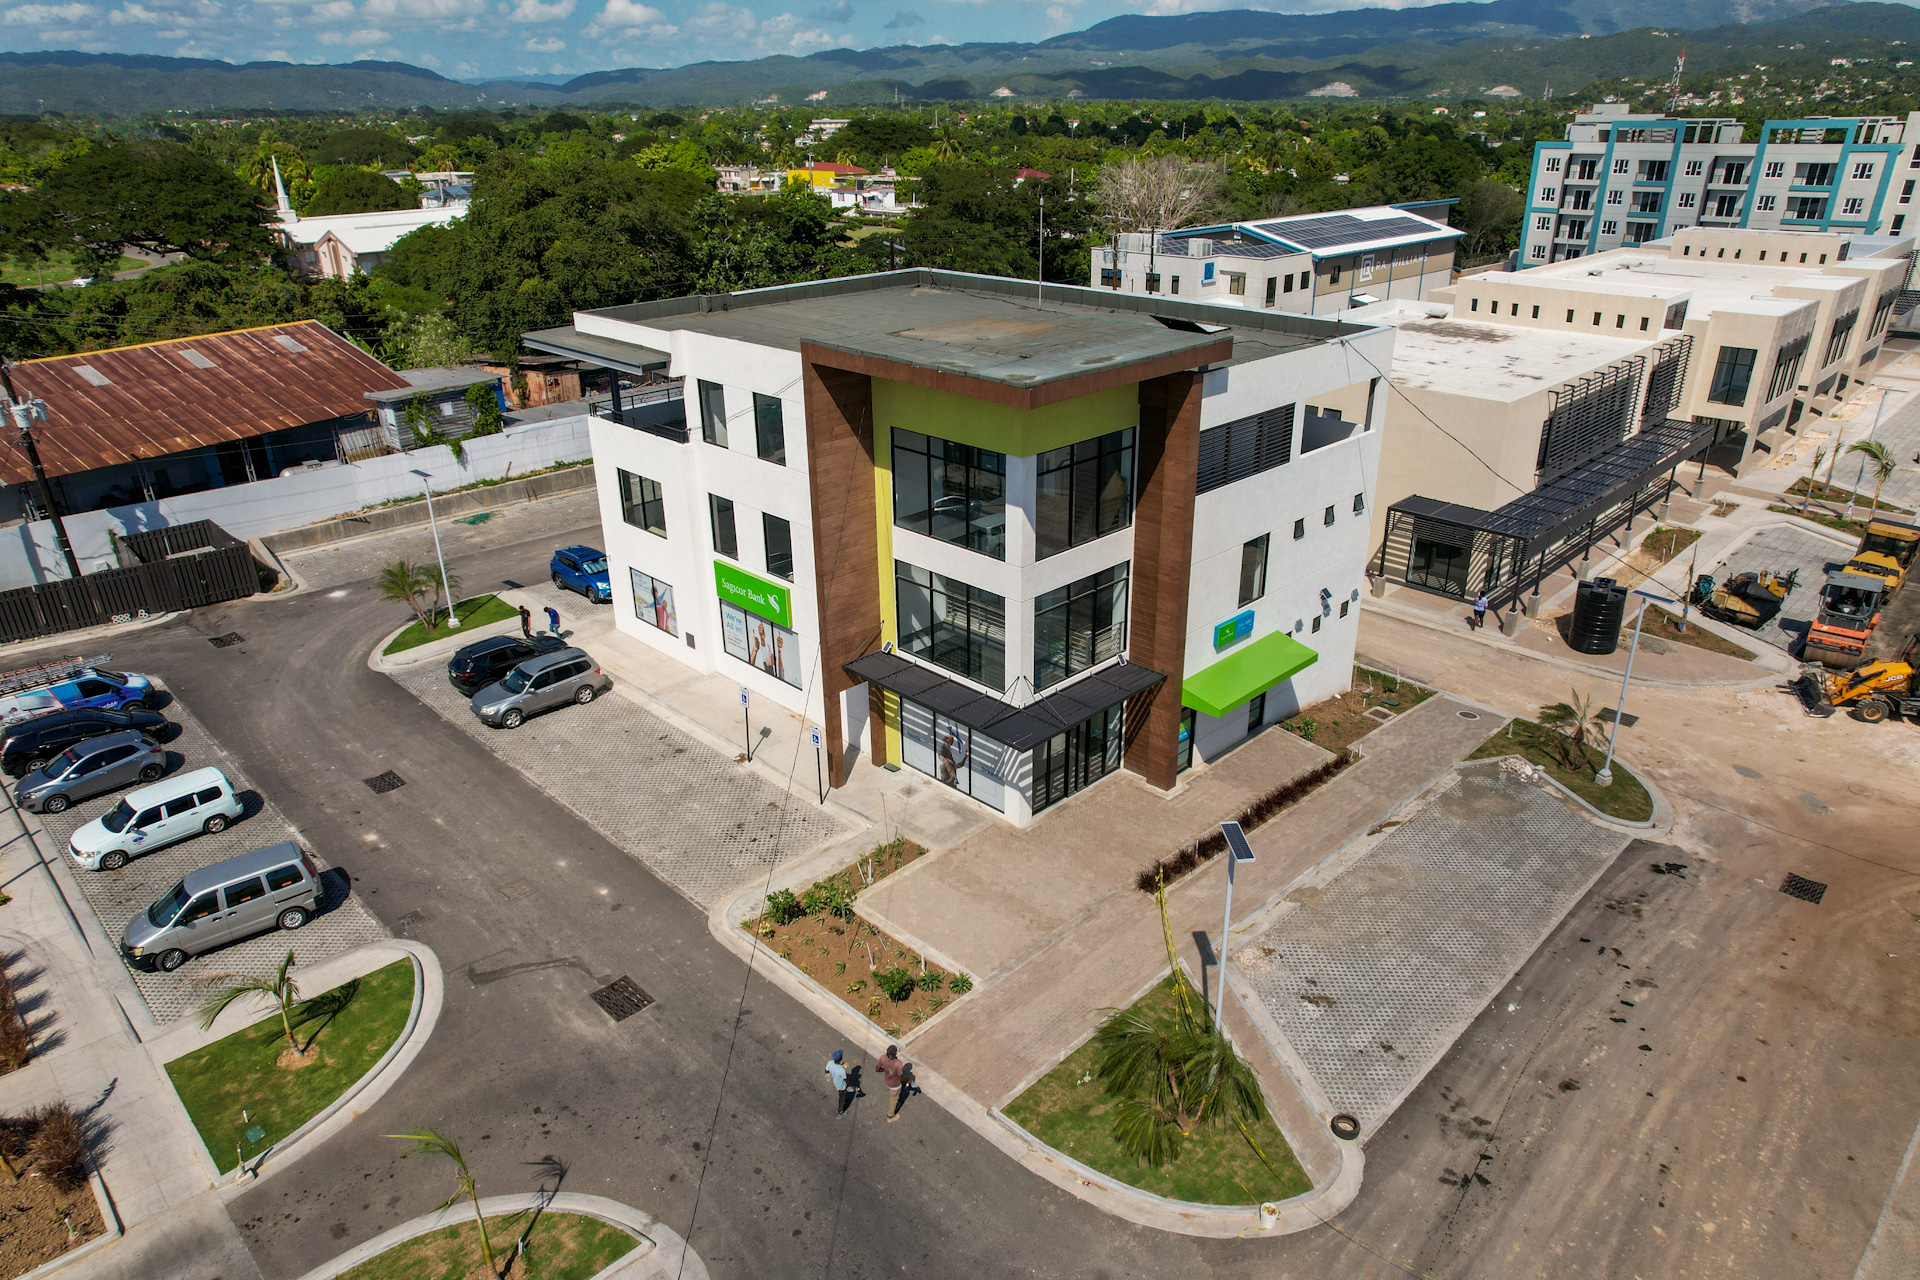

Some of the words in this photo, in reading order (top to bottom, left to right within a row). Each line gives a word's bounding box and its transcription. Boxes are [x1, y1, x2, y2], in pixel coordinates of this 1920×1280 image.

[1376, 260, 1386, 270] RA
[1392, 252, 1428, 268] WILLIAMS
[722, 577, 746, 596] Sagicor
[747, 588, 766, 605] Bank
[725, 612, 742, 625] We're
[726, 621, 735, 630] All
